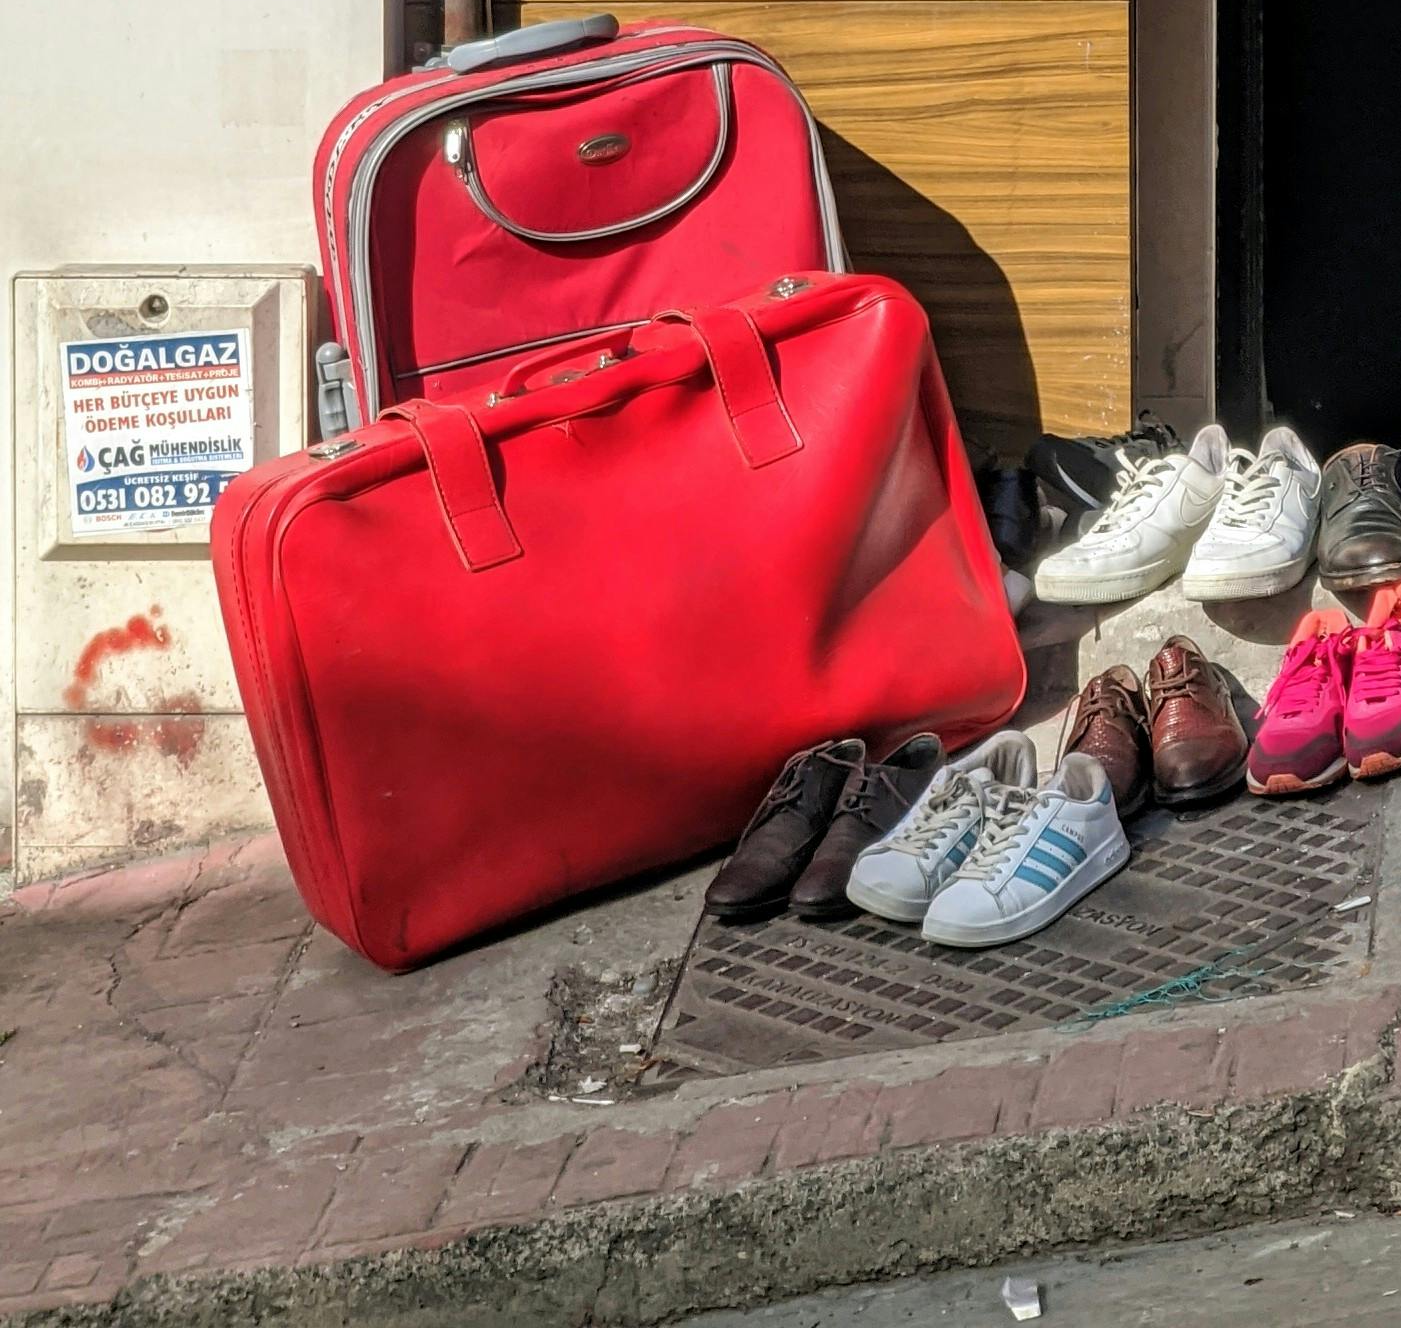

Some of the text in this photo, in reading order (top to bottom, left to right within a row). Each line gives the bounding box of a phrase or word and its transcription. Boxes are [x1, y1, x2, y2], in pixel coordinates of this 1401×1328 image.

[70, 342, 238, 375] DOĞALGAZ
[74, 384, 239, 413] HER BÜTÇEYE UYGUN
[85, 406, 232, 433] ÖDEME KOŞULLARI
[98, 435, 242, 474] ÇAĞ MÜHENDİSLİK
[124, 470, 199, 485] ÜCRETSİZ KEŞİF
[80, 487, 126, 512] 0531
[134, 484, 177, 508] 082
[184, 482, 211, 504] 92
[95, 514, 122, 523] BOSCH
